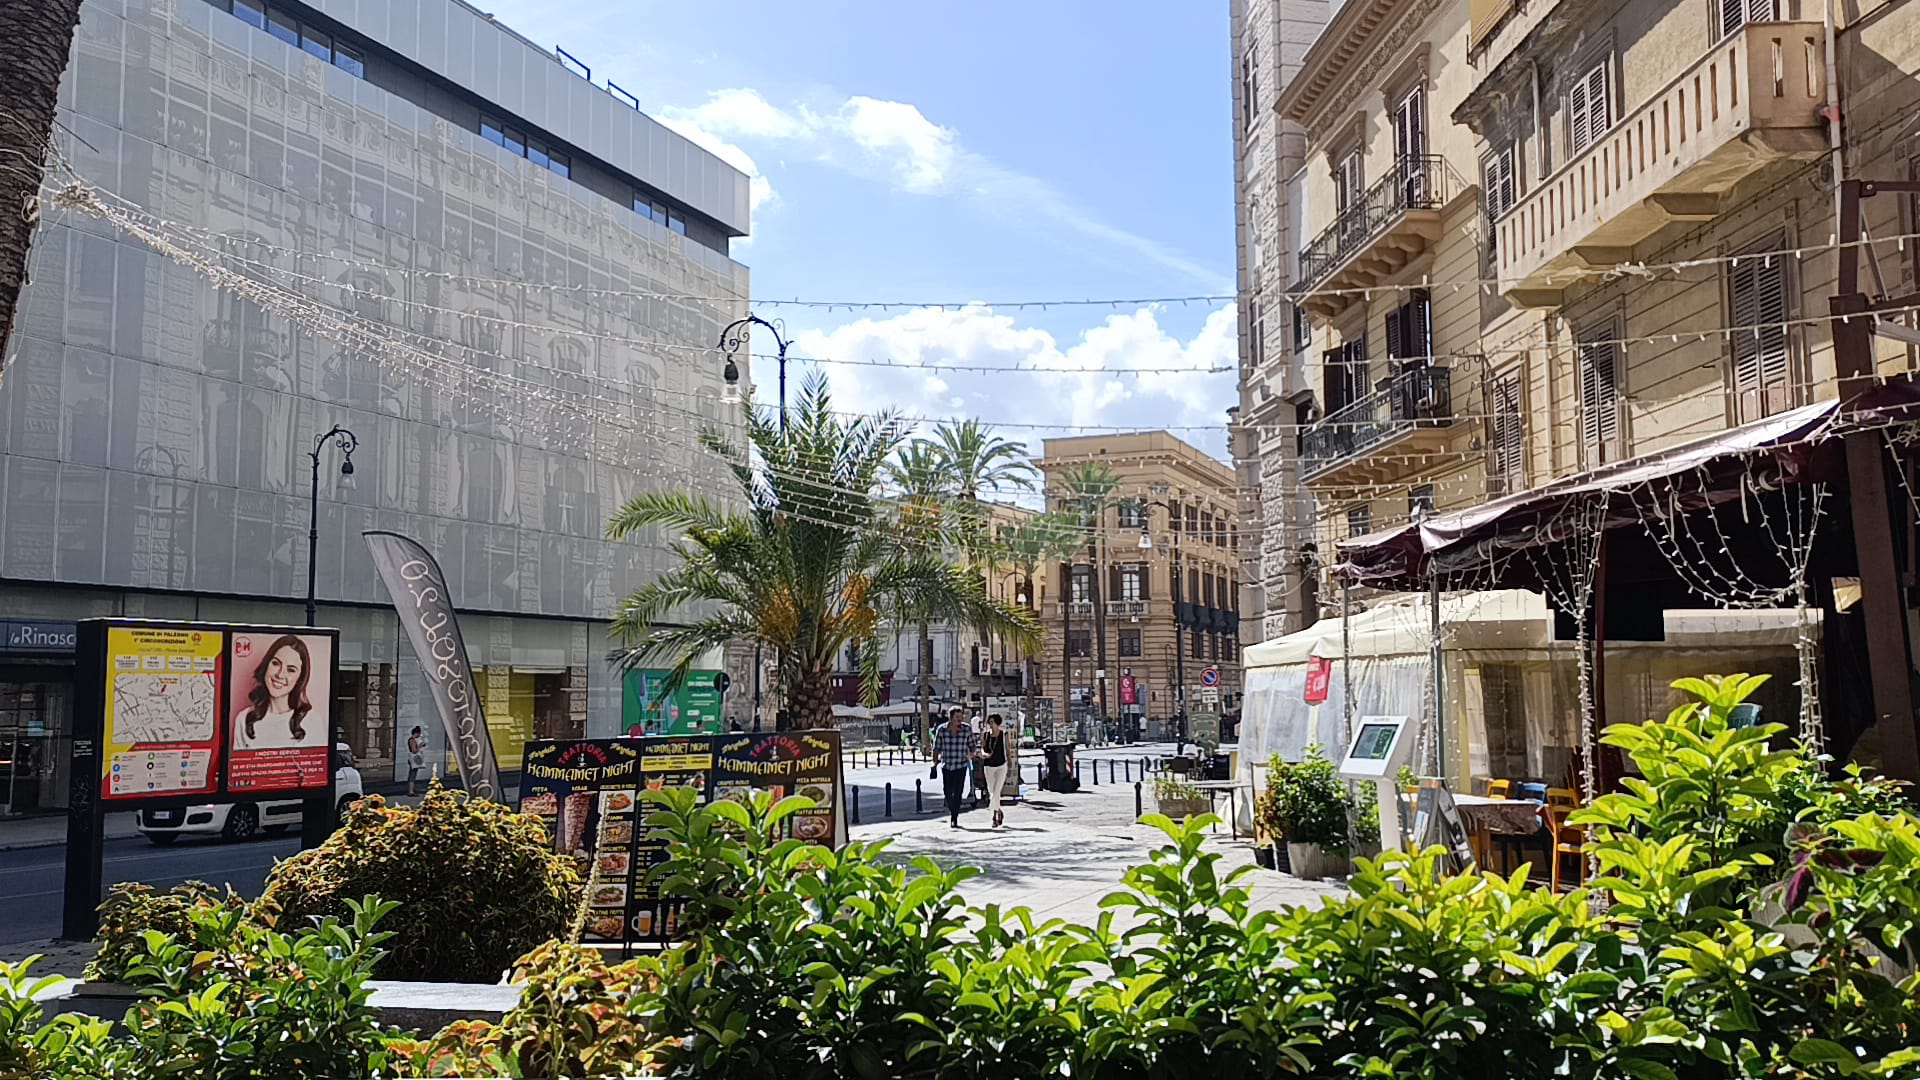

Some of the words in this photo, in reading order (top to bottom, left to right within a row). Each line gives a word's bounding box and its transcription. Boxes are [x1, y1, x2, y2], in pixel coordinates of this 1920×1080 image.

[558, 743, 609, 766] TRATTORIA
[749, 736, 803, 758] TRATTORIA
[527, 763, 600, 782] HAMMAMET
[601, 760, 636, 779] NIGHT
[718, 756, 793, 775] HAMMAMET
[796, 752, 831, 772] NIGHT
